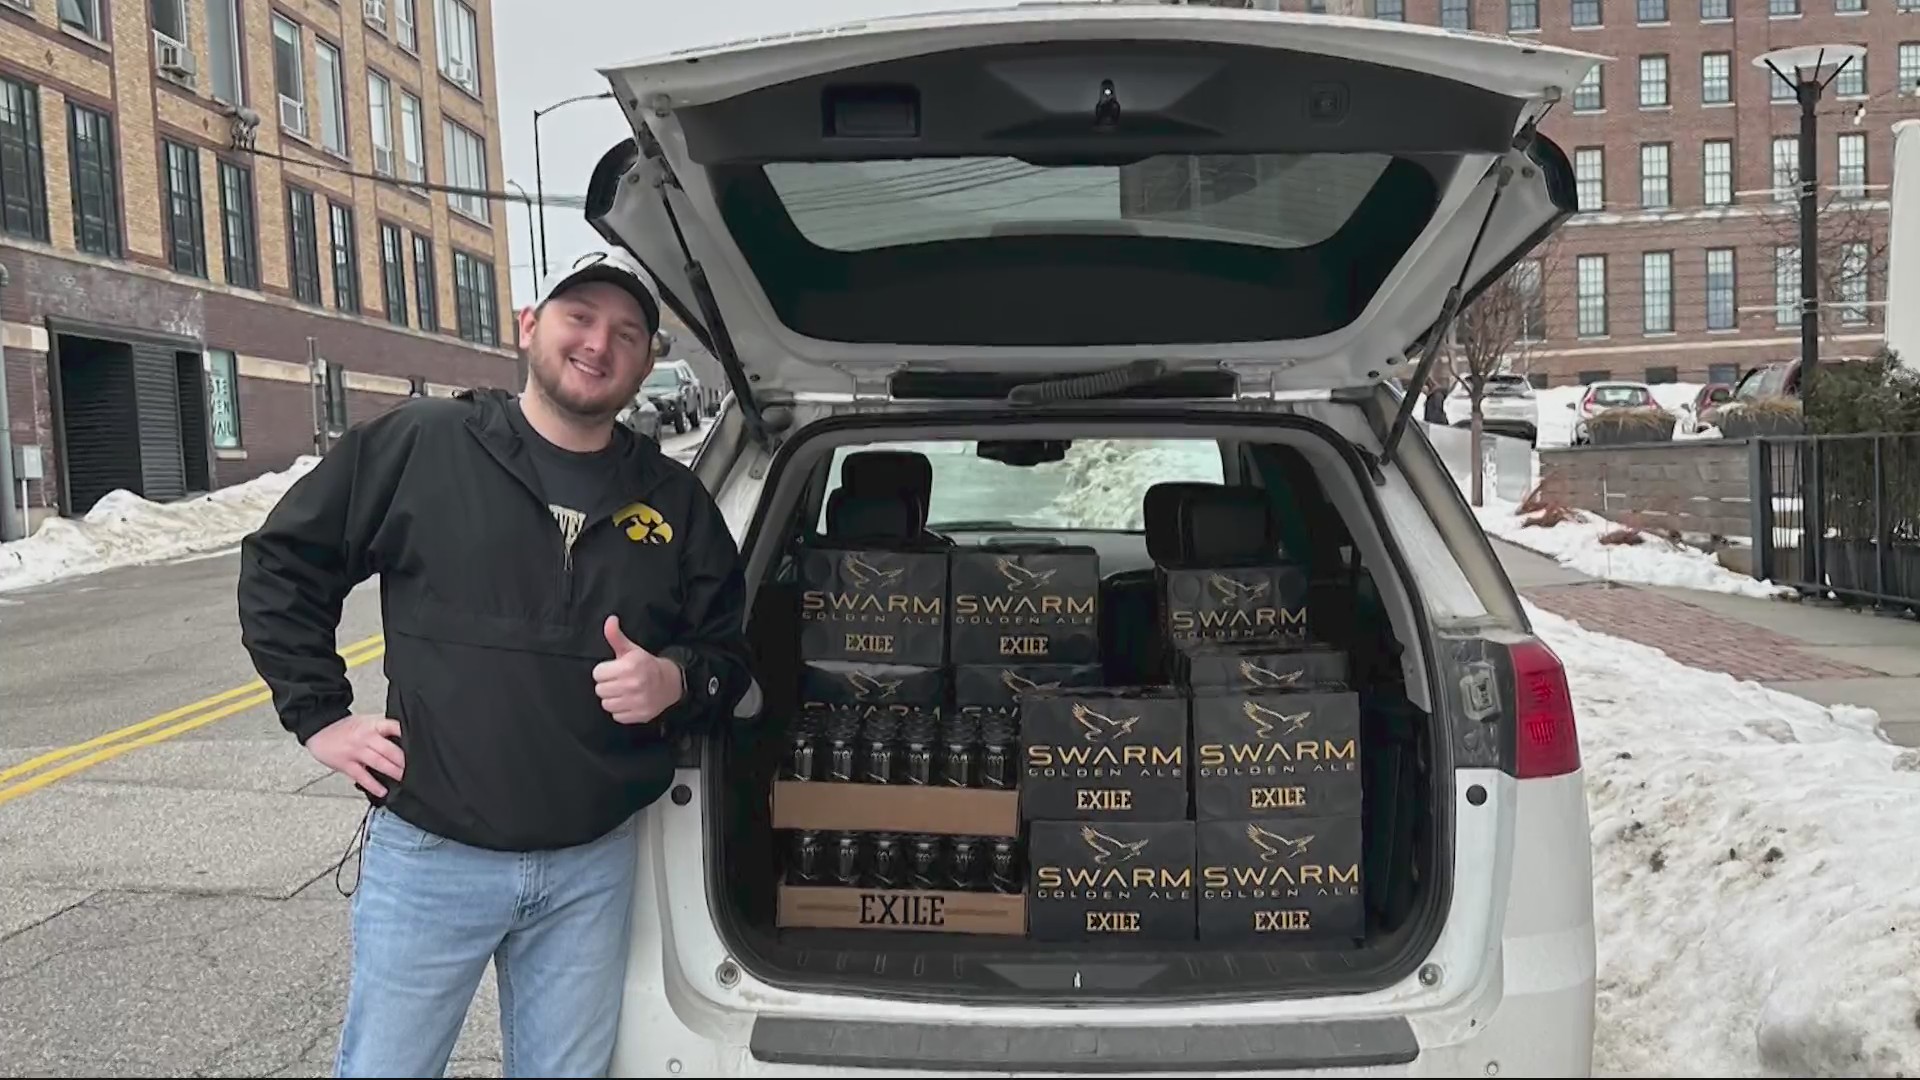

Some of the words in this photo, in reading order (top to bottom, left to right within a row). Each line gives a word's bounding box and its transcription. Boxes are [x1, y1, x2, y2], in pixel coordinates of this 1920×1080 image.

[803, 591, 941, 615] SWARM
[956, 594, 1094, 614] SWARM
[802, 612, 886, 623] GOLDEN
[902, 616, 939, 625] ALE
[956, 616, 1040, 625] GOLDEN
[1057, 616, 1093, 625] ALE
[1173, 607, 1307, 629] SWARM
[845, 633, 894, 653] EXILE
[1000, 636, 1049, 654] EXILE
[1028, 745, 1182, 765] SWARM
[1200, 740, 1356, 765] SWARM
[1028, 768, 1122, 777] GOLDEN
[1140, 768, 1182, 777] ALE
[1201, 765, 1295, 777] GOLDEN
[1313, 761, 1355, 772] ALE
[1076, 789, 1132, 811] EXILE
[1250, 786, 1306, 809] EXILE
[1038, 867, 1191, 888] SWARM
[1204, 863, 1359, 888] SWARM
[1037, 890, 1131, 900] GOLDEN
[1149, 890, 1190, 900] ALE
[1205, 889, 1299, 899] GOLDEN
[1317, 886, 1359, 897] ALE
[859, 894, 945, 926] EXILE
[1086, 910, 1140, 932] EXILE
[1254, 910, 1310, 932] EXILE
